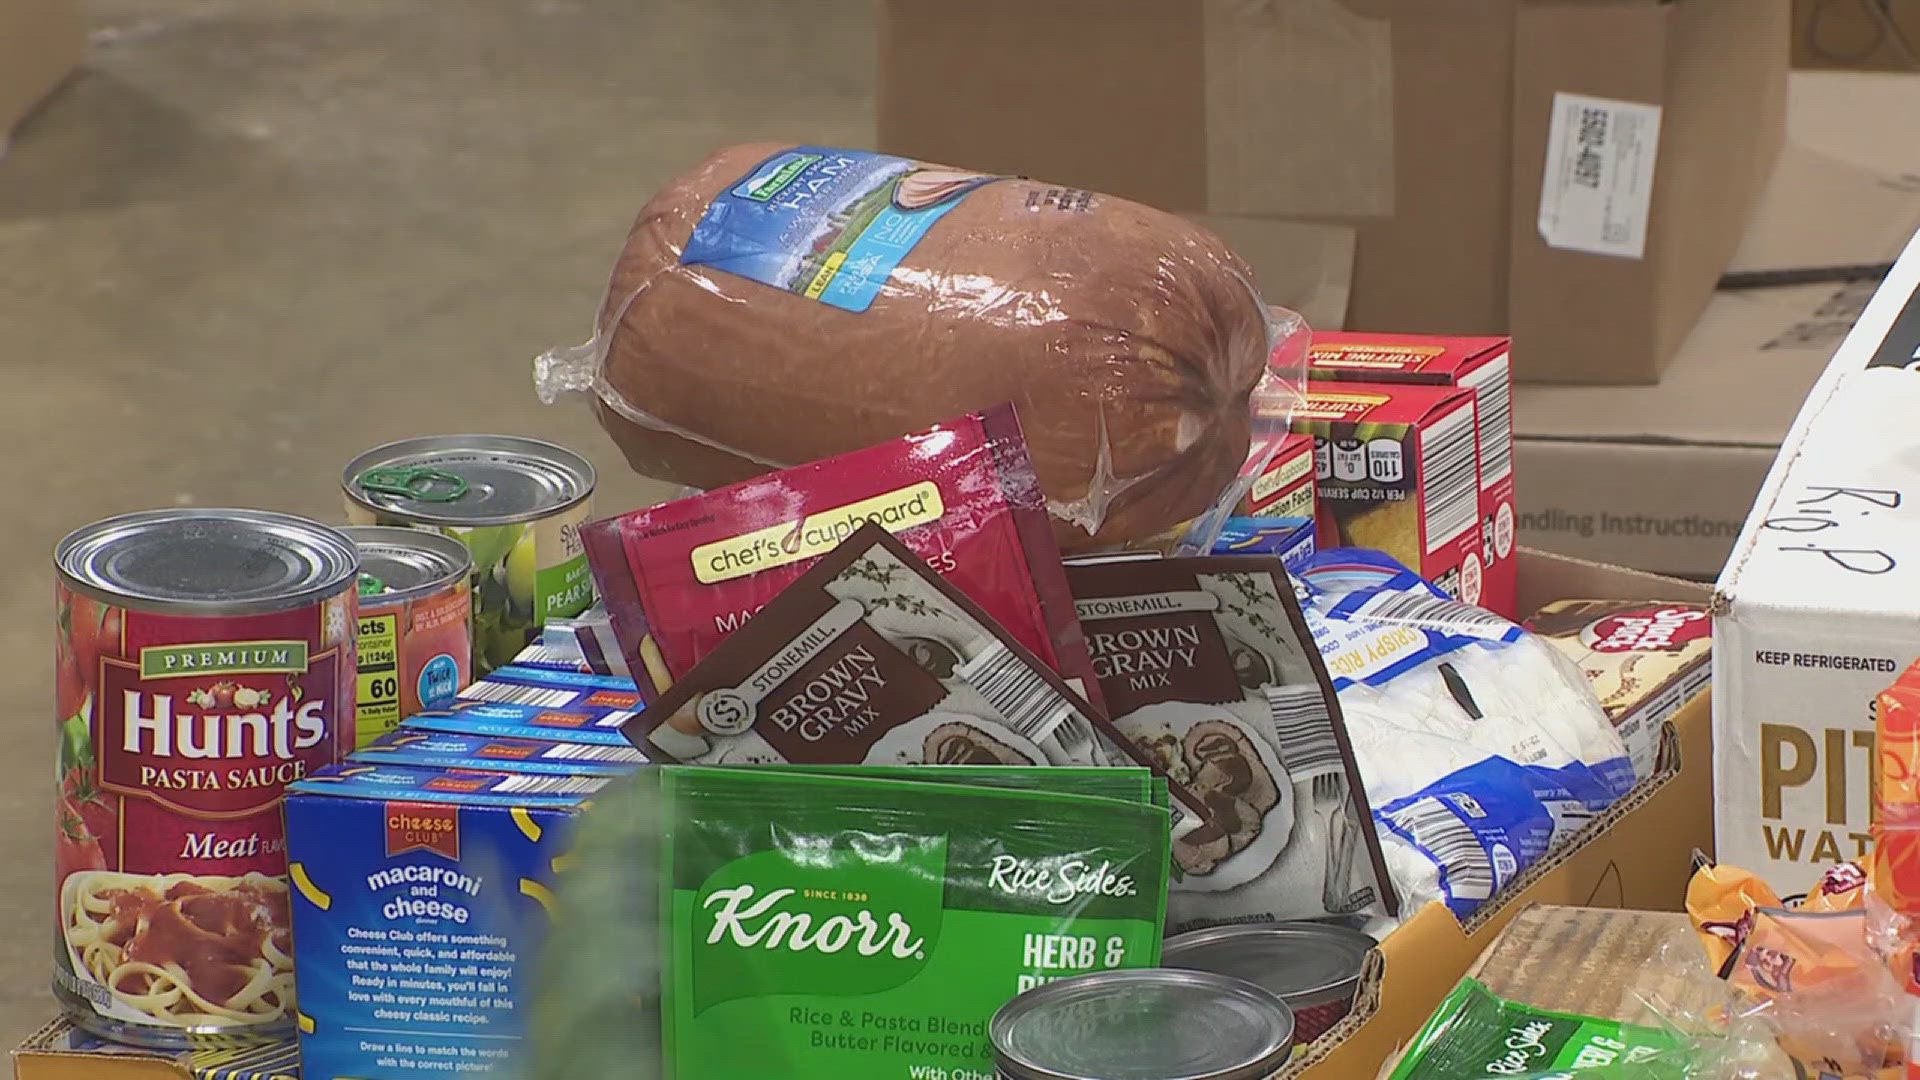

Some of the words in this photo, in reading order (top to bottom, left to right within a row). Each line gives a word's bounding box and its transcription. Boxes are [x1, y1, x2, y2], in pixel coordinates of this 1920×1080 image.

[782, 157, 855, 209] HAM
[811, 264, 835, 294] LEAN
[1345, 353, 1428, 363] STUFFING
[1373, 460, 1399, 478] 110
[1351, 488, 1370, 500] CUP
[1371, 488, 1385, 500] 1/2
[1386, 489, 1406, 500] PER
[710, 537, 781, 573] chef's
[358, 637, 392, 651] ontainer
[1365, 627, 1418, 663] CRISPY
[164, 649, 290, 669] PREMIUM
[1090, 647, 1197, 680] GRAVY
[1329, 649, 1366, 674] RICE
[1755, 650, 1791, 666] KEEP
[1794, 653, 1897, 673] REFRIGERATED
[370, 676, 397, 699] 60
[769, 643, 877, 733] BROWN
[1129, 672, 1172, 692] MIX
[799, 664, 888, 743] GRAVY
[842, 704, 881, 738] MIX
[141, 766, 221, 790] PASTA
[227, 760, 306, 790] SAUCE
[388, 813, 454, 832] cheese
[180, 832, 260, 859] Meat
[367, 864, 482, 898] macaroni
[988, 854, 1053, 894] Rice
[410, 885, 438, 898] and
[803, 888, 839, 899] SINCE
[383, 897, 469, 925] cheese
[348, 927, 387, 941] Cheese
[389, 928, 414, 942] Club
[416, 930, 448, 944] offers
[451, 933, 507, 949] something
[403, 946, 435, 959] quick,
[437, 949, 458, 960] and
[460, 949, 516, 963] affordable
[1023, 932, 1097, 969] HERB
[1104, 935, 1125, 968] &
[346, 960, 368, 970] that
[371, 960, 388, 971] the
[390, 962, 422, 973] whole
[424, 963, 457, 978] family
[459, 965, 478, 976] will
[480, 966, 512, 979] enjoy!
[352, 975, 386, 989] Ready
[387, 976, 398, 988] in
[478, 981, 496, 992] fall
[498, 982, 508, 993] in
[348, 990, 371, 1001] love
[372, 991, 396, 1003] with
[397, 994, 428, 1007] every
[429, 995, 477, 1008] mouthful
[479, 997, 491, 1009] of
[493, 998, 514, 1010] this
[374, 1008, 411, 1022] cheesy
[412, 1010, 450, 1022] classic
[452, 1012, 490, 1025] recipe.
[789, 1006, 833, 1026] Rice
[838, 1010, 855, 1028] &
[861, 1011, 921, 1034] Pasta
[360, 1041, 386, 1052] Draw
[387, 1044, 393, 1053] a
[395, 1042, 413, 1053] line
[415, 1044, 426, 1055] to
[427, 1045, 459, 1056] match
[460, 1046, 477, 1058] the
[478, 1047, 509, 1059] words
[810, 1029, 879, 1052] Butter
[883, 1034, 975, 1059] Flavored
[376, 1056, 398, 1068] with
[399, 1057, 416, 1069] the
[417, 1059, 454, 1071] correct
[908, 1064, 949, 1080] With
[951, 1067, 994, 1080] Othe
[1486, 1049, 1530, 1075] Rice
